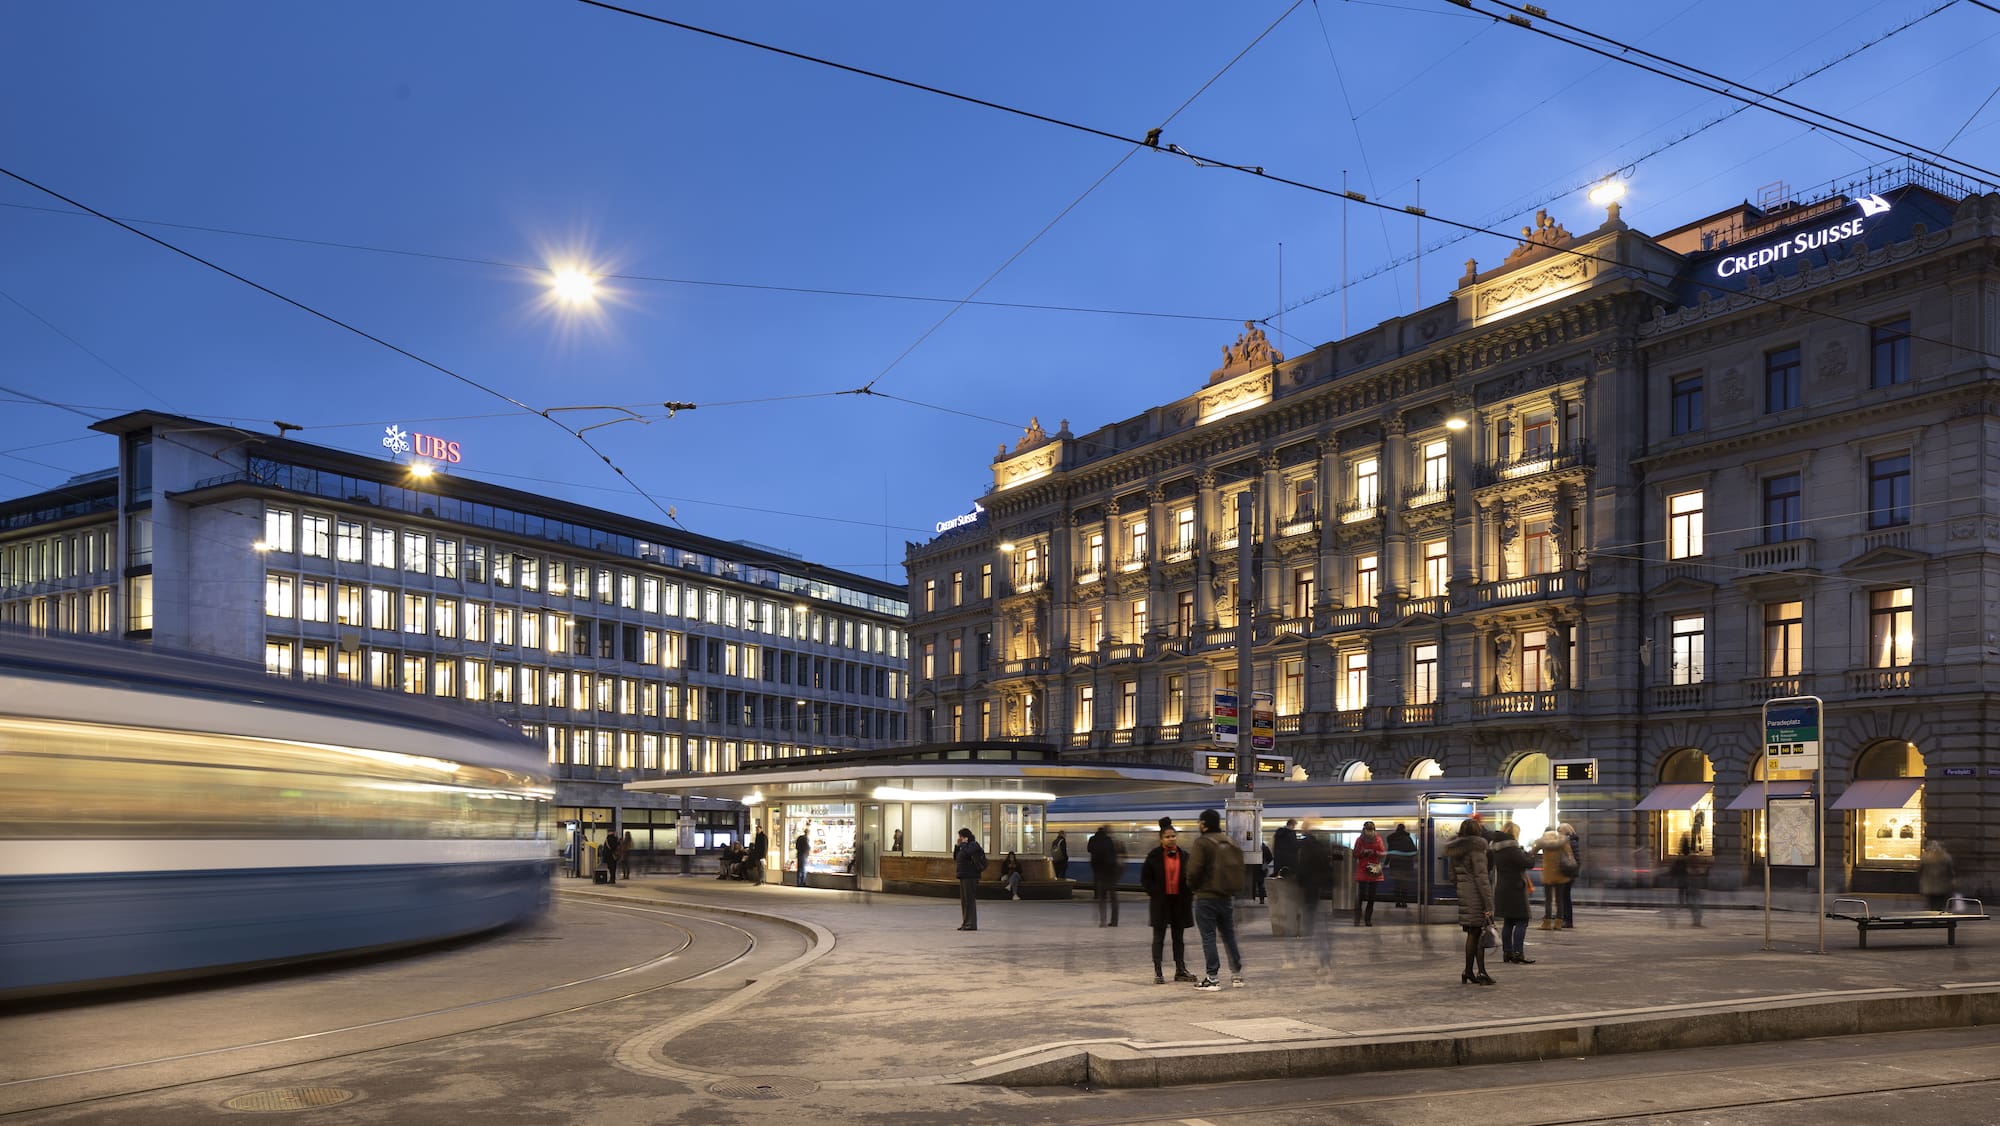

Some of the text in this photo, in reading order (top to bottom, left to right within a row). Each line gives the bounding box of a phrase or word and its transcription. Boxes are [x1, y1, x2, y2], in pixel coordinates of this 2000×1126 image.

[1717, 218, 1864, 278] CREDIT SUISSE
[413, 432, 461, 463] UBS
[936, 512, 977, 533] CREDIT SUISSE
[1767, 719, 1800, 727] Paradeplatz
[1771, 734, 1779, 742] 11
